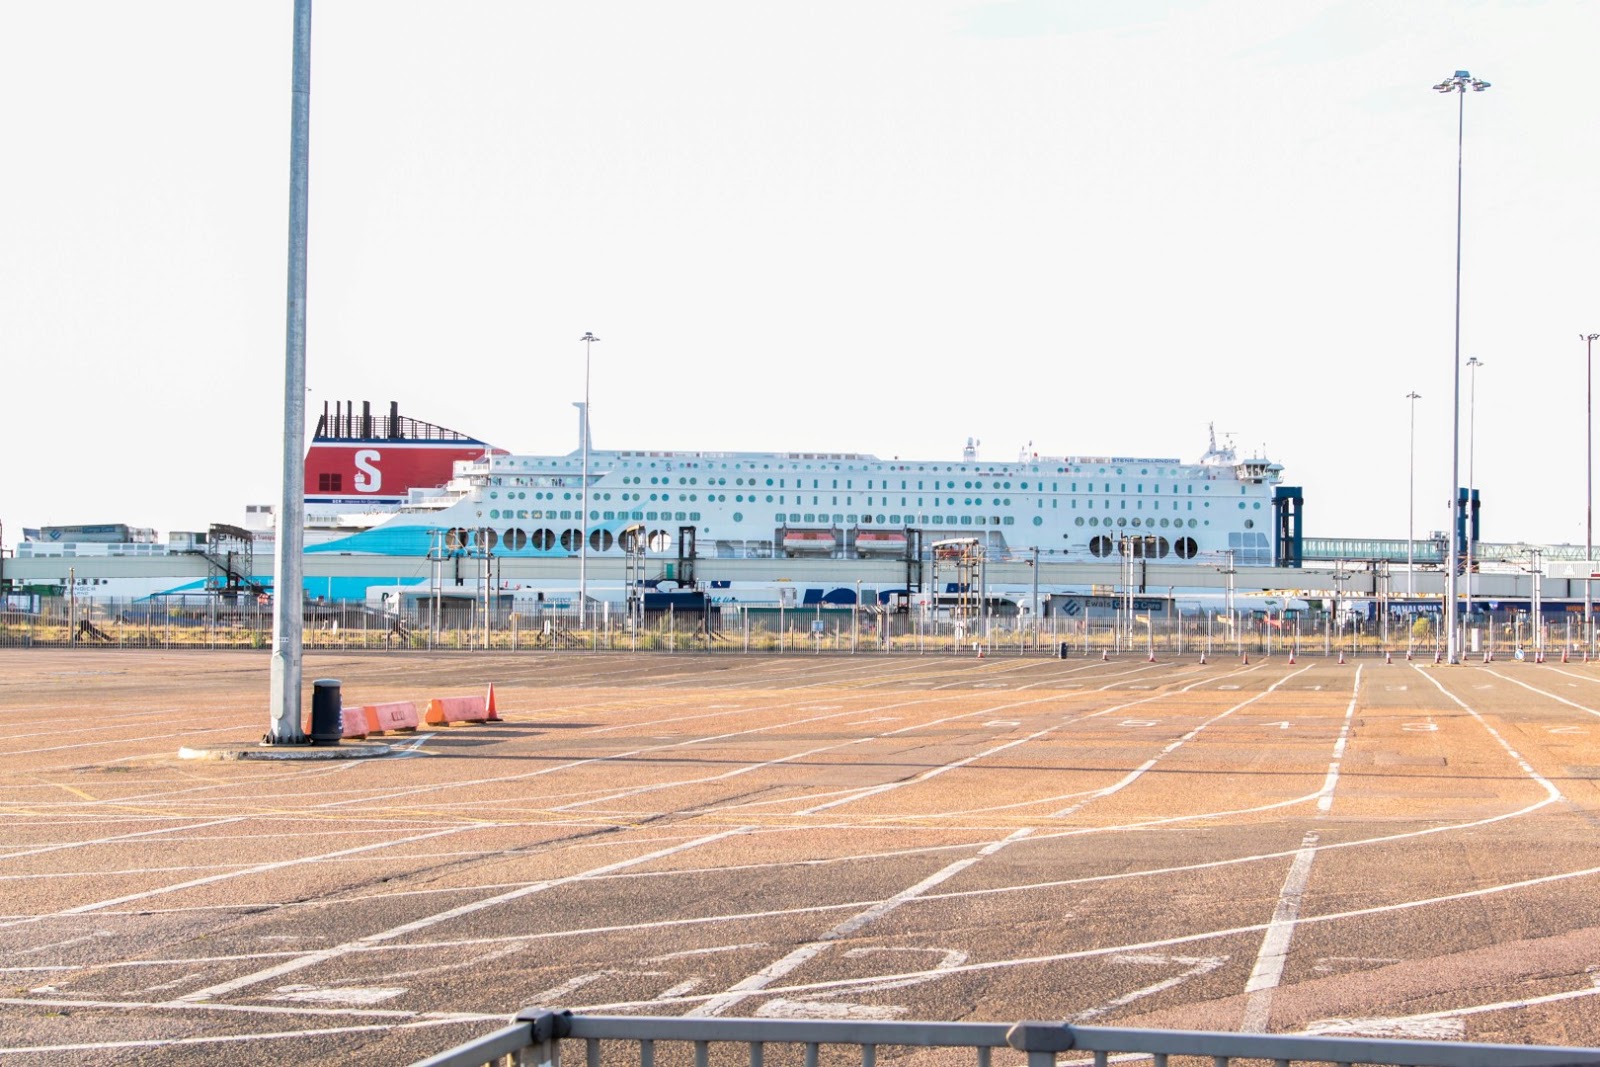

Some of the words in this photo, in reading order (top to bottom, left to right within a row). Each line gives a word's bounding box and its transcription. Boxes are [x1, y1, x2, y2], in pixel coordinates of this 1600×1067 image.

[354, 449, 382, 492] S
[1401, 722, 1439, 731] 3
[1541, 725, 1590, 734] 2
